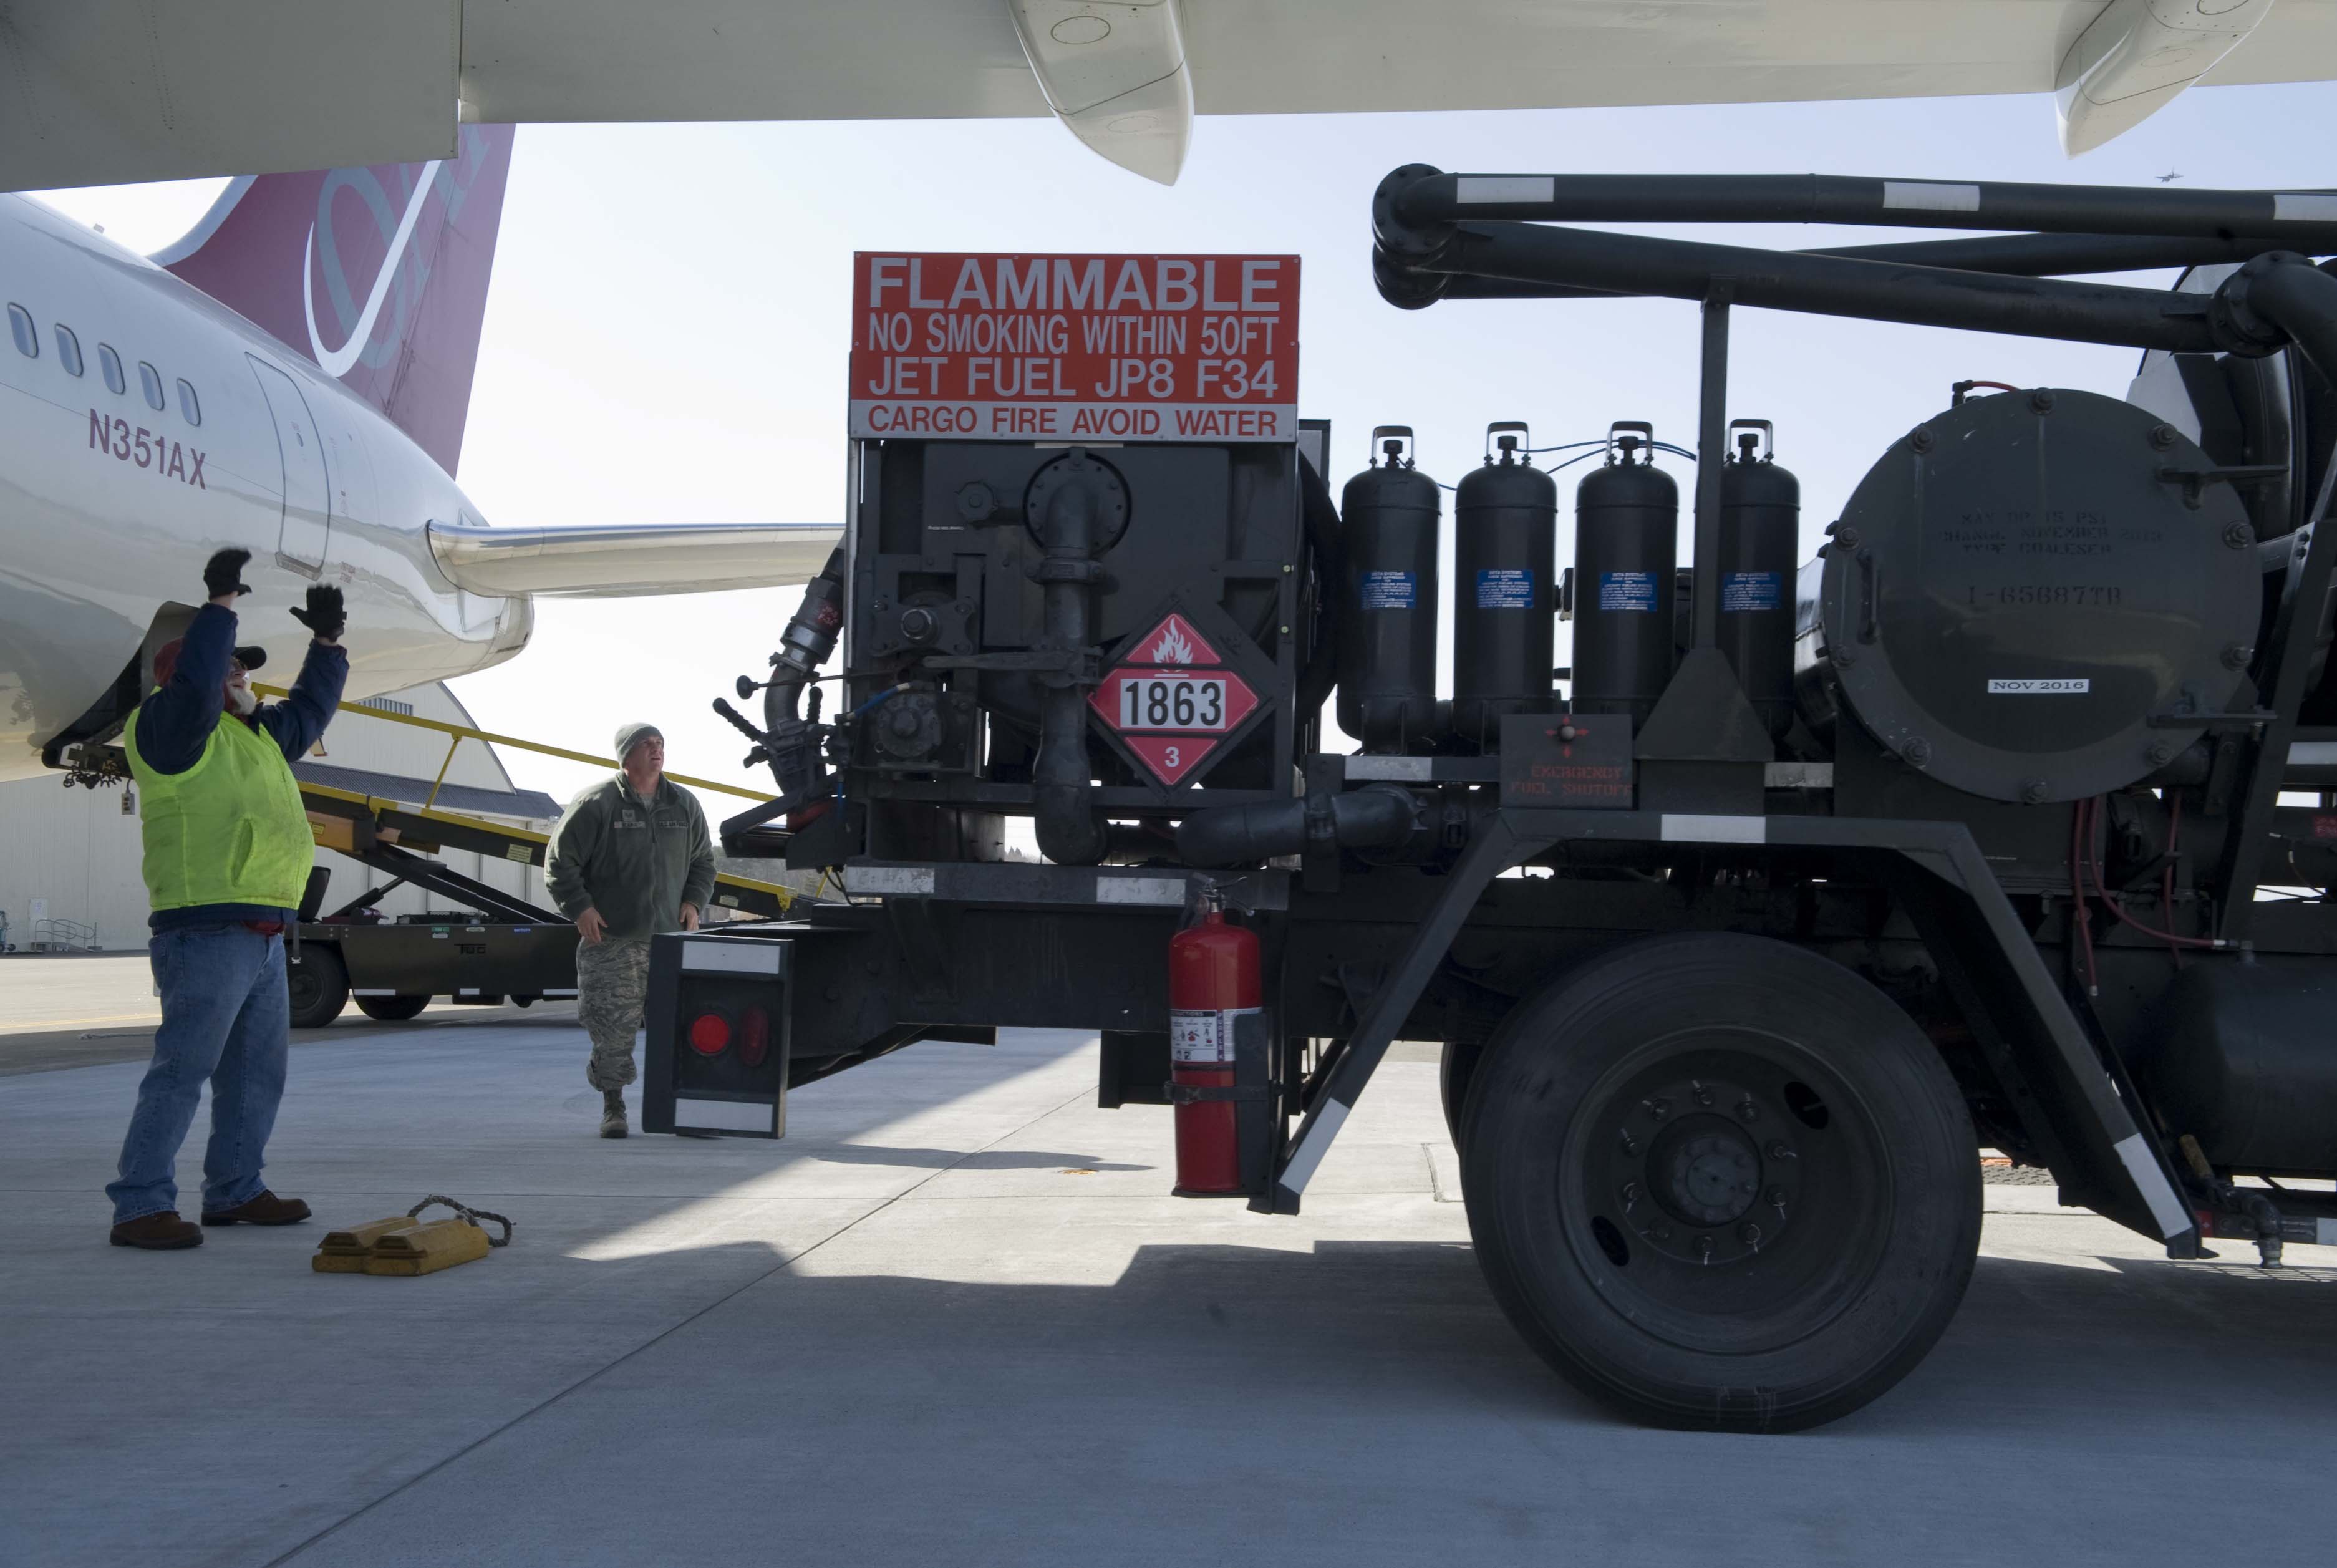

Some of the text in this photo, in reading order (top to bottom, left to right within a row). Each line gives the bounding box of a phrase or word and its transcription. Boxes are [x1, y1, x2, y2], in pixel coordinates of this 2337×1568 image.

[869, 258, 1280, 311] FLAMMABLE
[868, 312, 1280, 356] NO SMOKING WITHIN 50FT
[869, 356, 1279, 399] JET FUEL JP8 F34
[868, 405, 1277, 437] CARGO FIRE AVOID WATER
[89, 408, 206, 490] N351AX
[1125, 681, 1221, 726] 1863
[1164, 746, 1180, 767] 3
